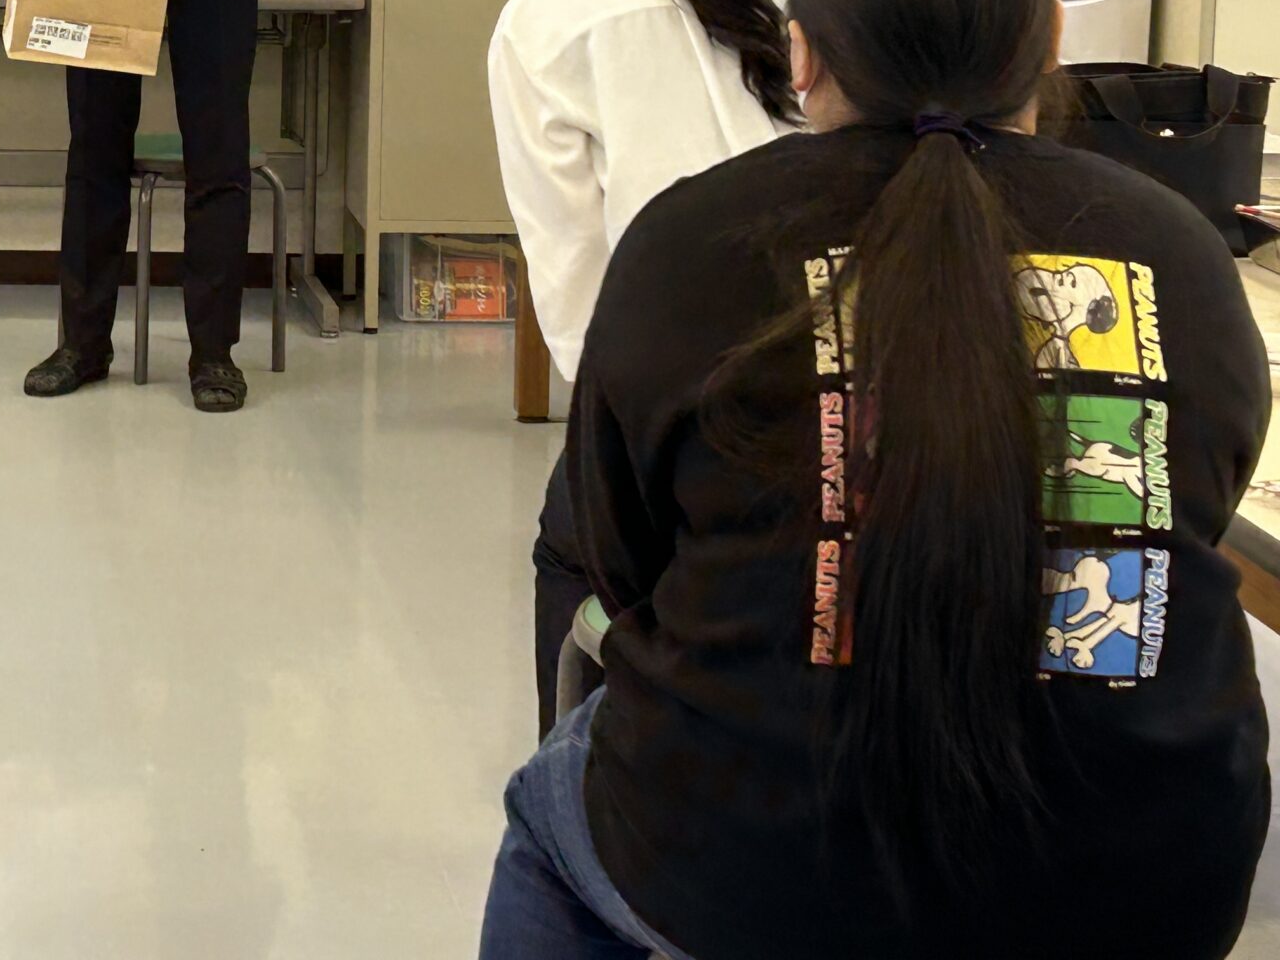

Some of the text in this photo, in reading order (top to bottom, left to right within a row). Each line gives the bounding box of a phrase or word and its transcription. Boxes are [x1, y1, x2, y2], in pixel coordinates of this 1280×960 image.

[1128, 261, 1168, 382] PEANUTS
[819, 392, 845, 522] PEANUTS
[1144, 398, 1173, 530] PEANUTS
[810, 540, 840, 665] PEANUTS
[1138, 547, 1171, 678] PEANUTS
